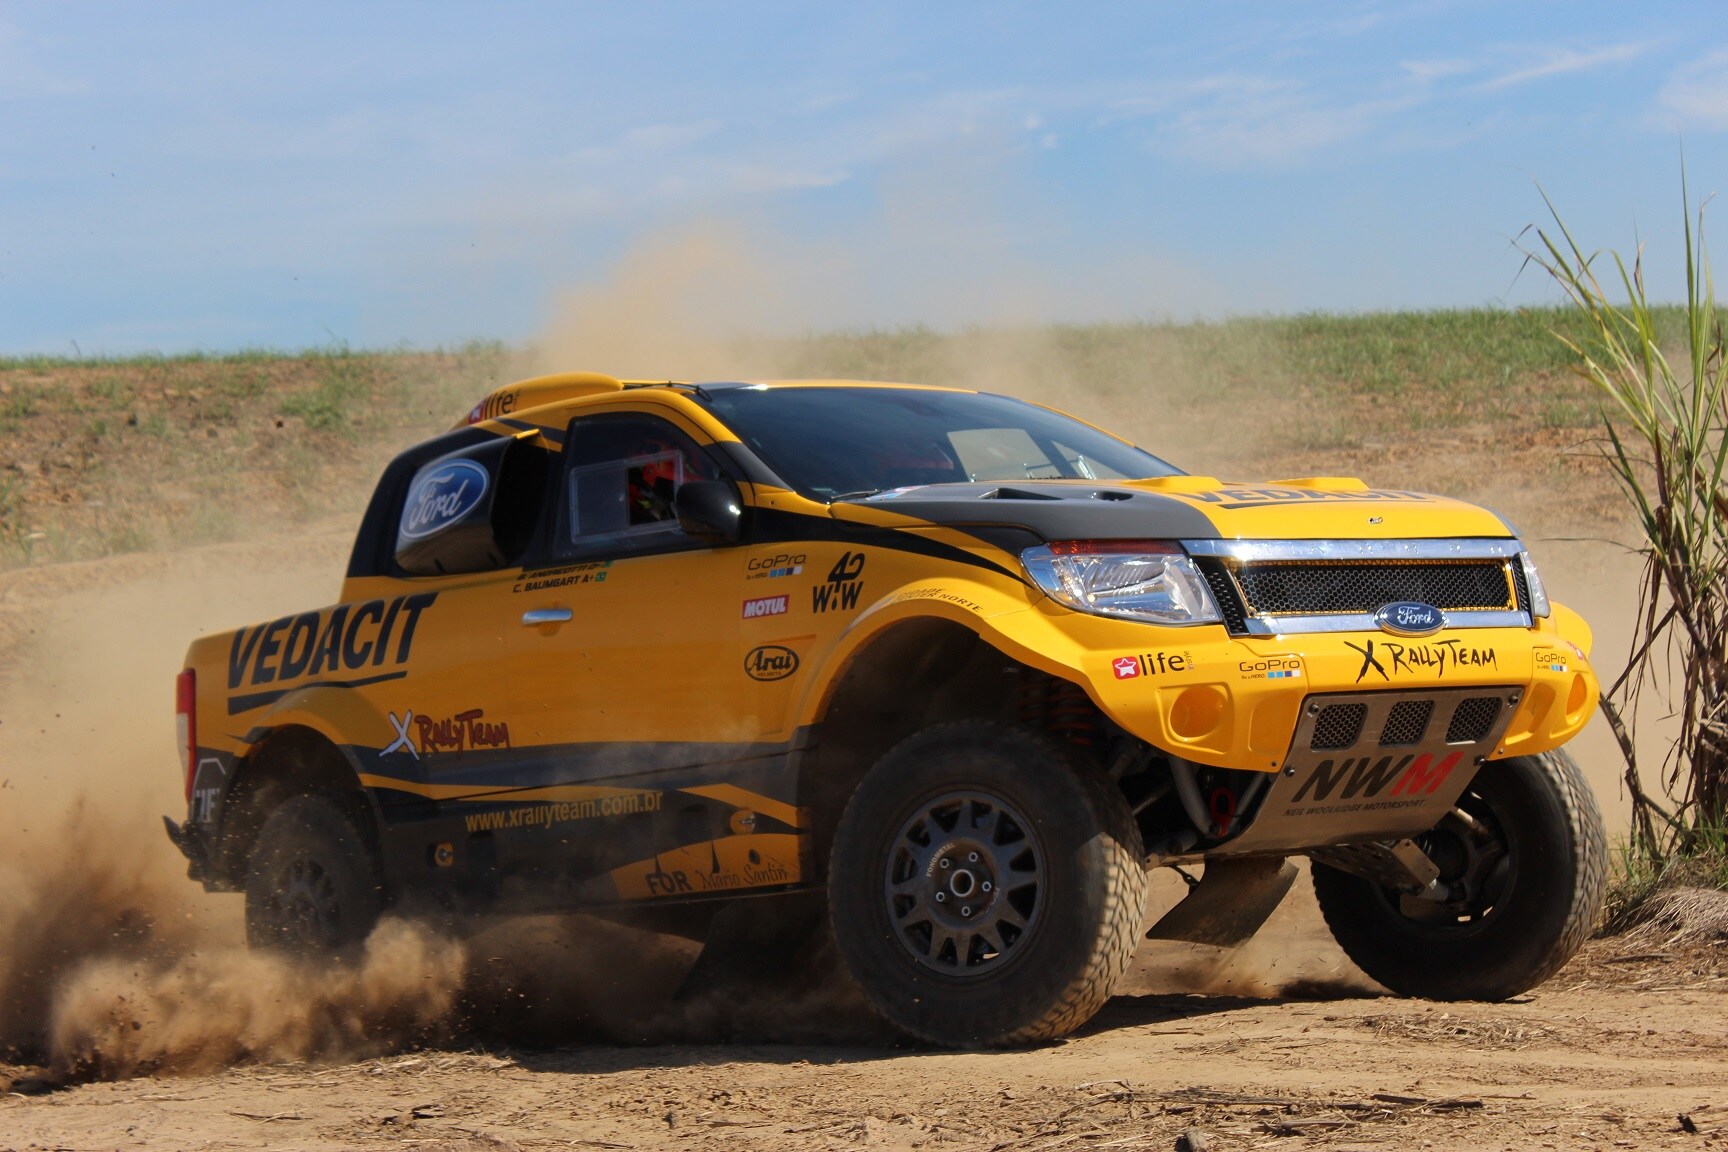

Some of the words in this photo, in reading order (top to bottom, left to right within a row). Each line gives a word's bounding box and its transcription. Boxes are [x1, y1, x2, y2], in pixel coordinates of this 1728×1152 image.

[408, 472, 468, 529] Ford
[748, 554, 806, 571] GoPro
[827, 551, 865, 593] 42
[524, 575, 581, 591] BAUMGART
[743, 597, 786, 618] MOTUL
[939, 593, 983, 613] NORTE
[1397, 607, 1435, 625] Ford
[228, 592, 440, 689] VEDACIT
[748, 651, 792, 671] Arai
[1140, 652, 1185, 676] life
[1239, 659, 1300, 672] GoPro
[1343, 639, 1390, 683] X
[1535, 652, 1567, 664] GoPro
[379, 709, 420, 760] X
[1291, 751, 1464, 803] NWM
[465, 791, 663, 832] www.xrallyteam.com.br
[1283, 808, 1305, 816] NEIL
[1306, 803, 1361, 815] WOOLRIDGE
[1363, 800, 1426, 810] MOTORSPORT
[645, 870, 693, 894] FOR
